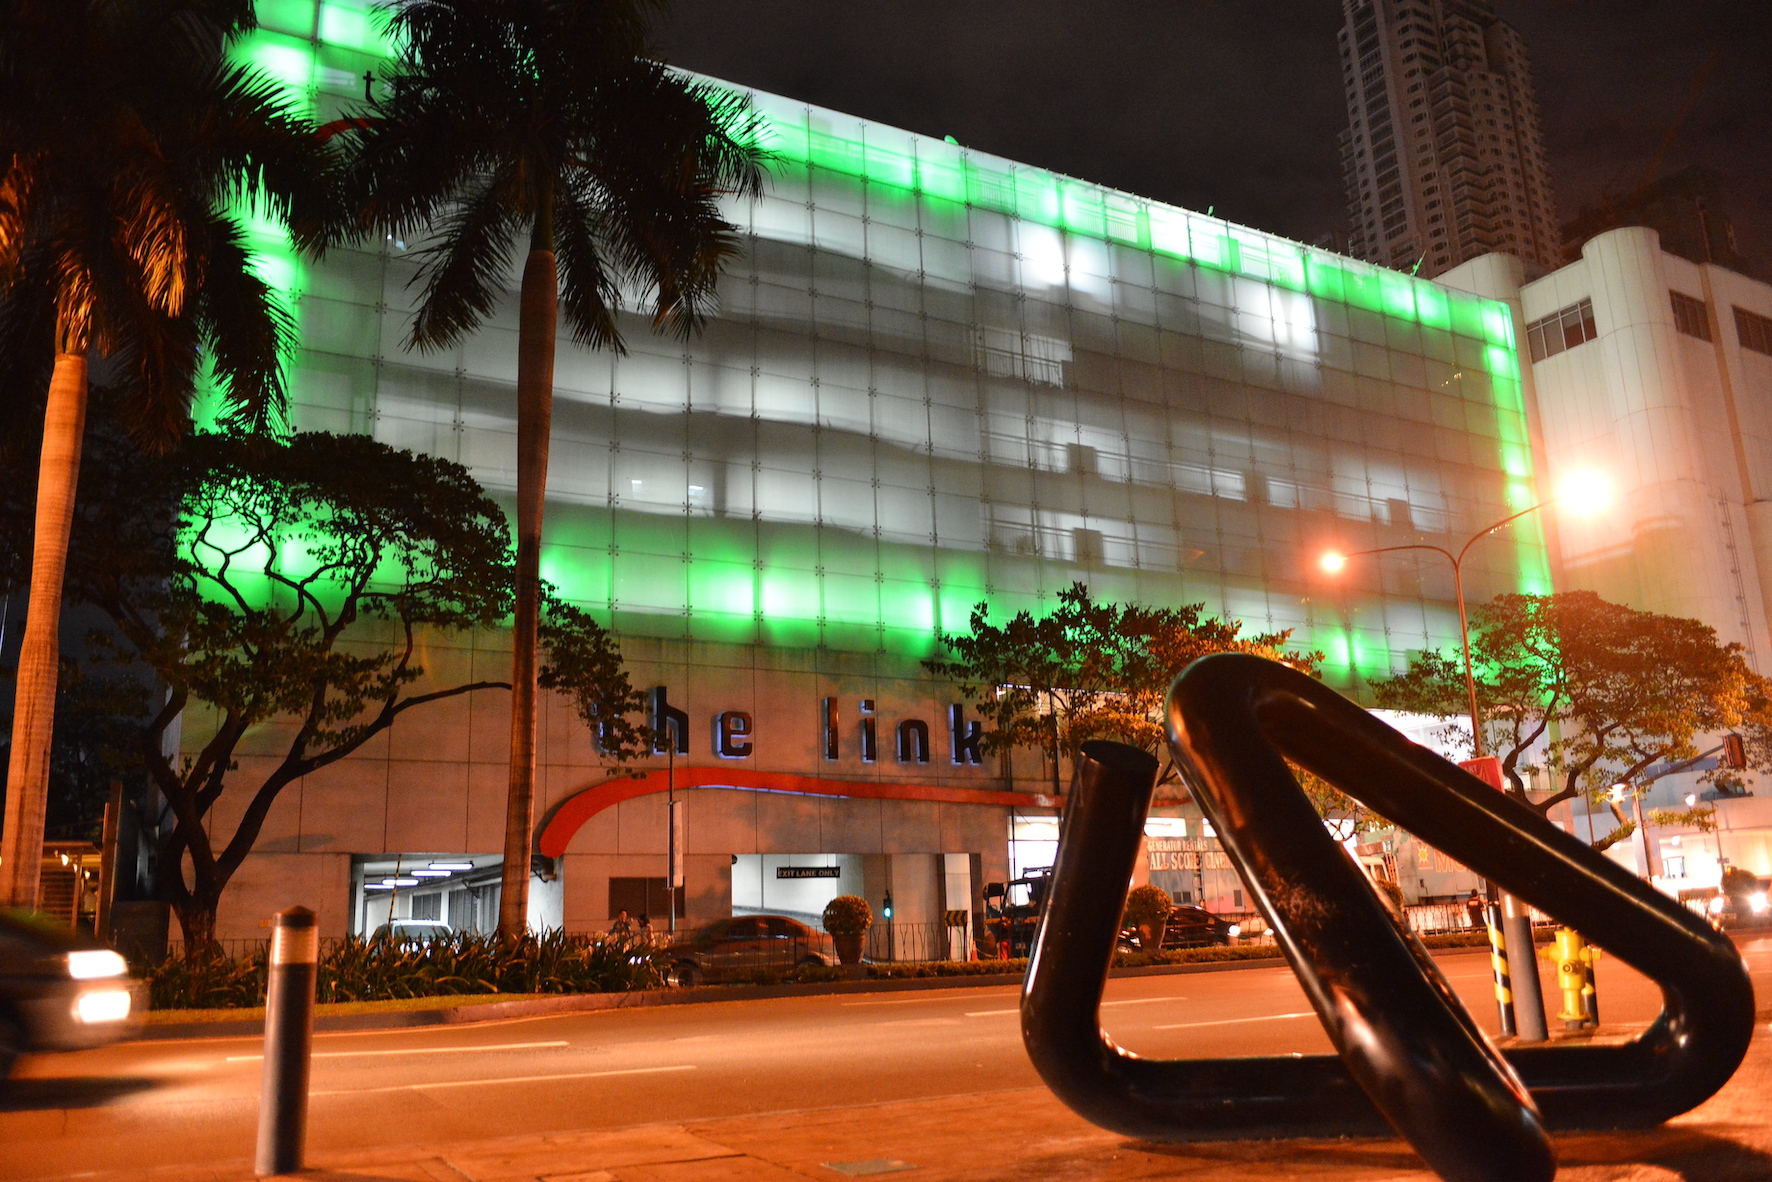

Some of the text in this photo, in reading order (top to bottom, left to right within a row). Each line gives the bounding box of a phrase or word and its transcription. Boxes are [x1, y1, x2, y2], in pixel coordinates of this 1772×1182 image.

[824, 697, 984, 765] link
[1148, 840, 1181, 851] GENERATOR
[1150, 853, 1169, 870] ALL
[778, 870, 795, 878] EXIT
[818, 869, 839, 877] ONLY
